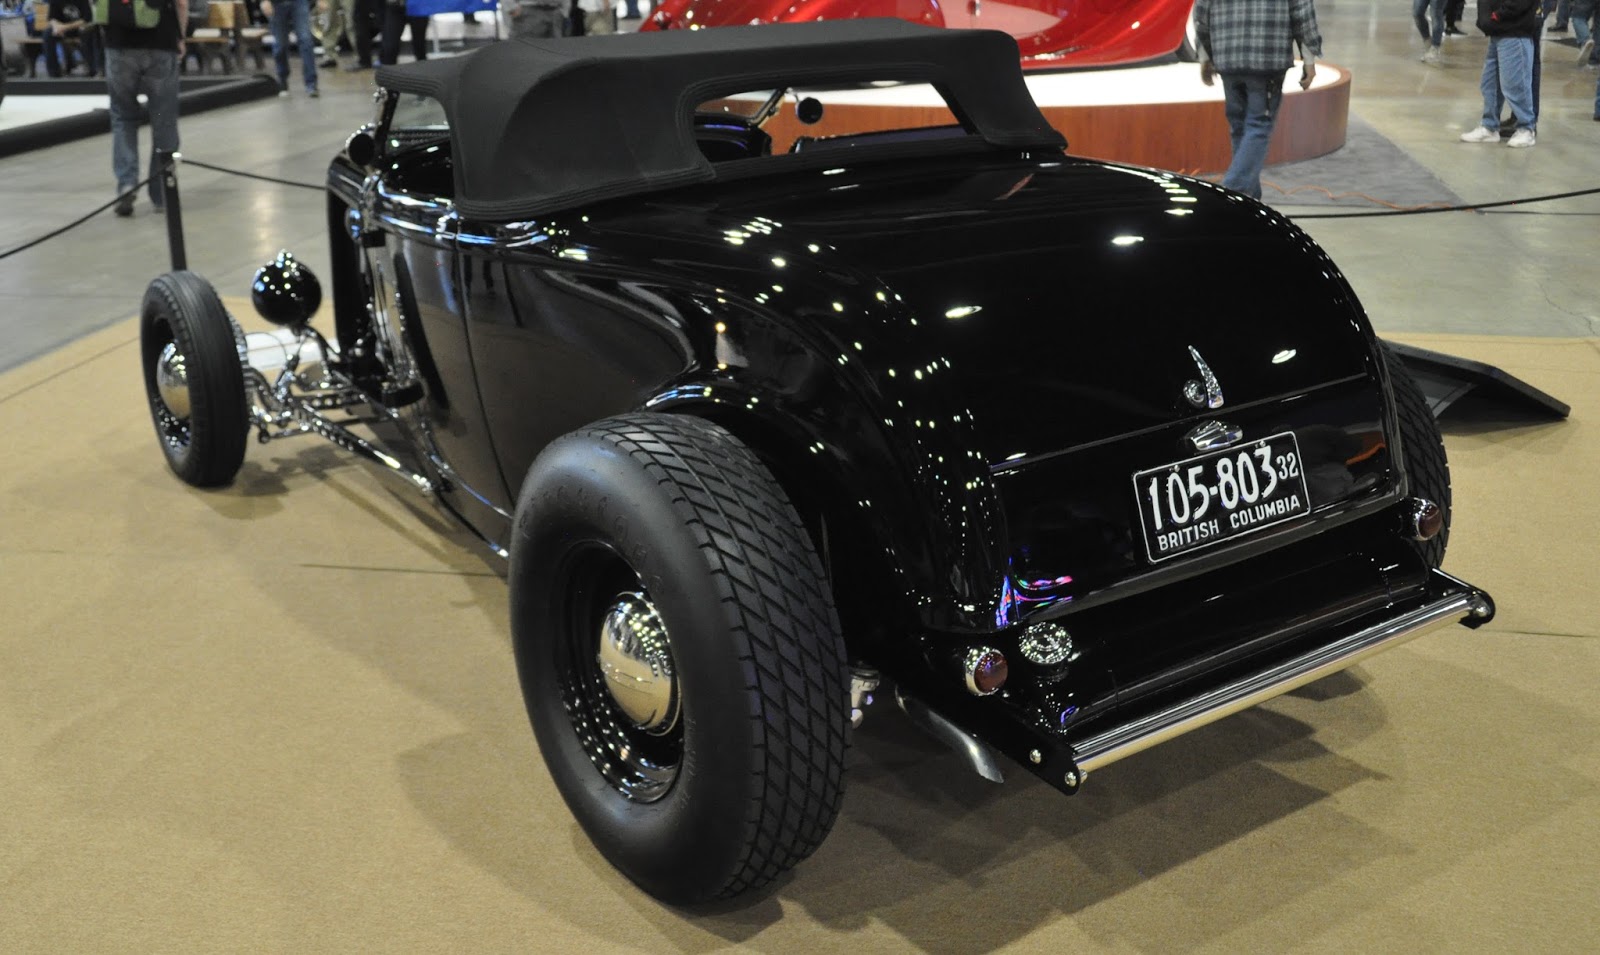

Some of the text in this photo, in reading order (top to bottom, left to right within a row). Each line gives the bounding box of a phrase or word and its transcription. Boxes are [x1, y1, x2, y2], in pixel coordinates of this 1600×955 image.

[1148, 445, 1299, 531] 105-803 32
[1157, 494, 1301, 551] BRITISH COLUMBIA
